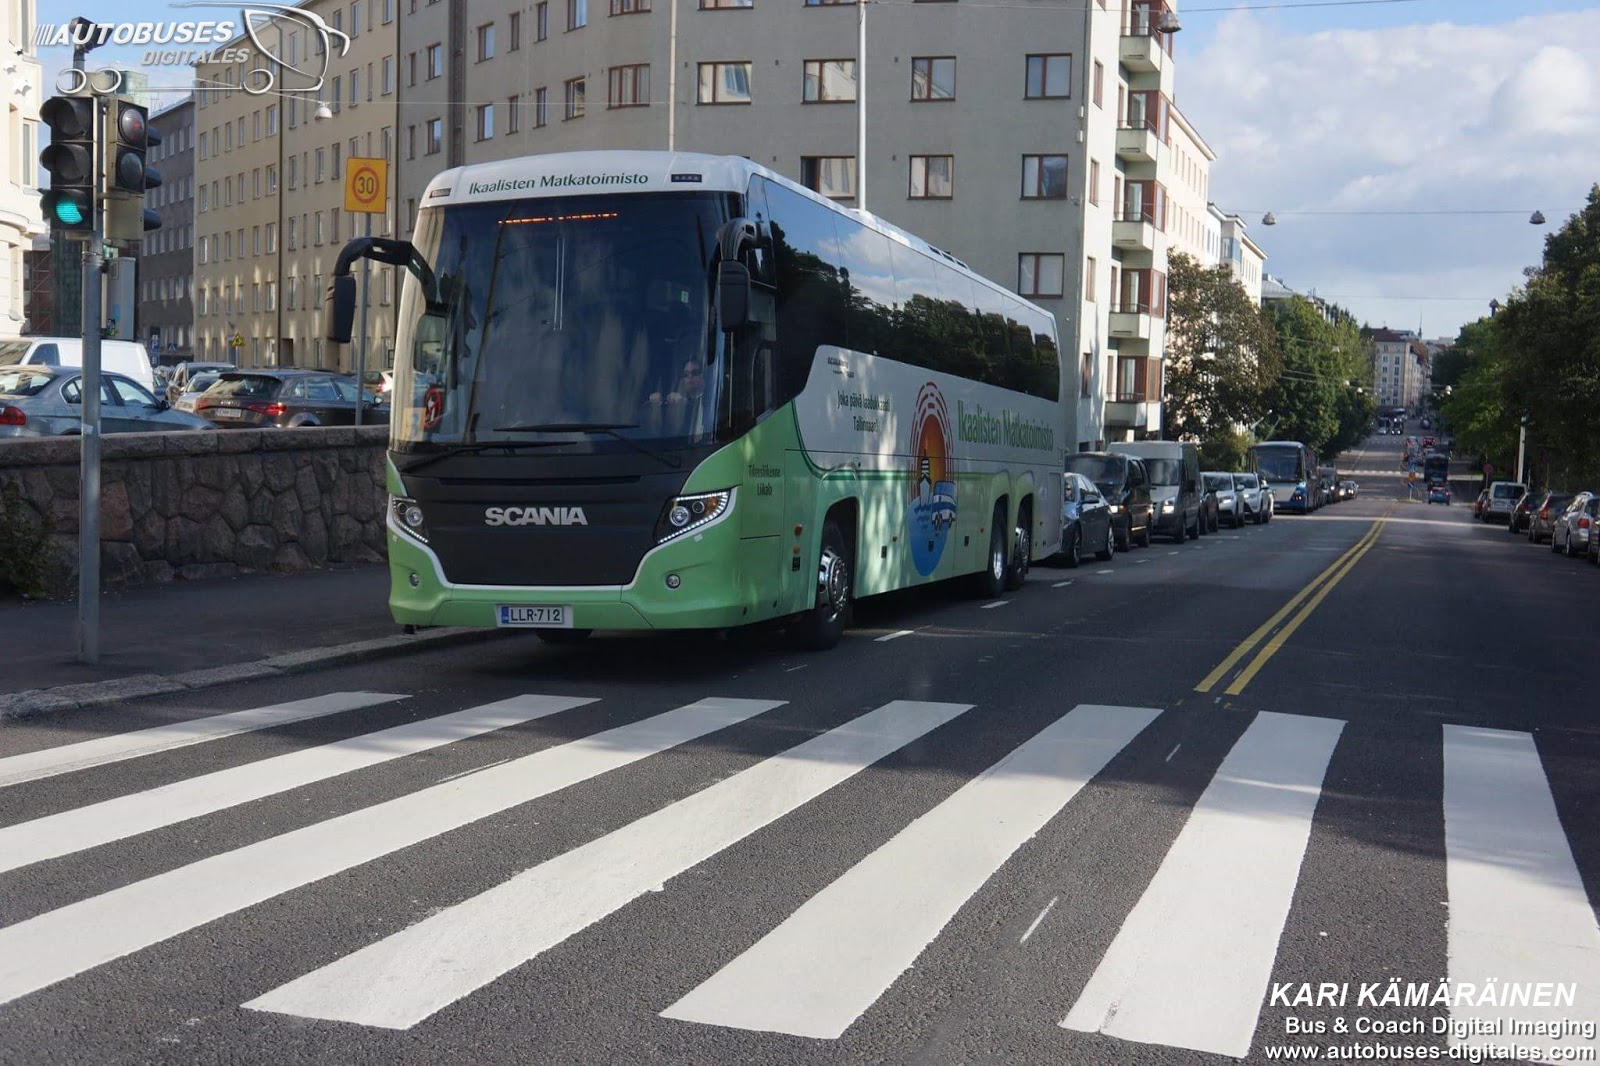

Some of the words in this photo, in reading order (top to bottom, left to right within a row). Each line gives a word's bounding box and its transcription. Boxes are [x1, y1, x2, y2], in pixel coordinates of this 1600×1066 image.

[357, 176, 374, 194] 30
[469, 178, 536, 195] Ikaalisten
[540, 172, 649, 188] Matkatoimisto
[958, 399, 1002, 446] Ikaalisten
[485, 507, 589, 526] SCANIA
[511, 608, 560, 622] LLR-712
